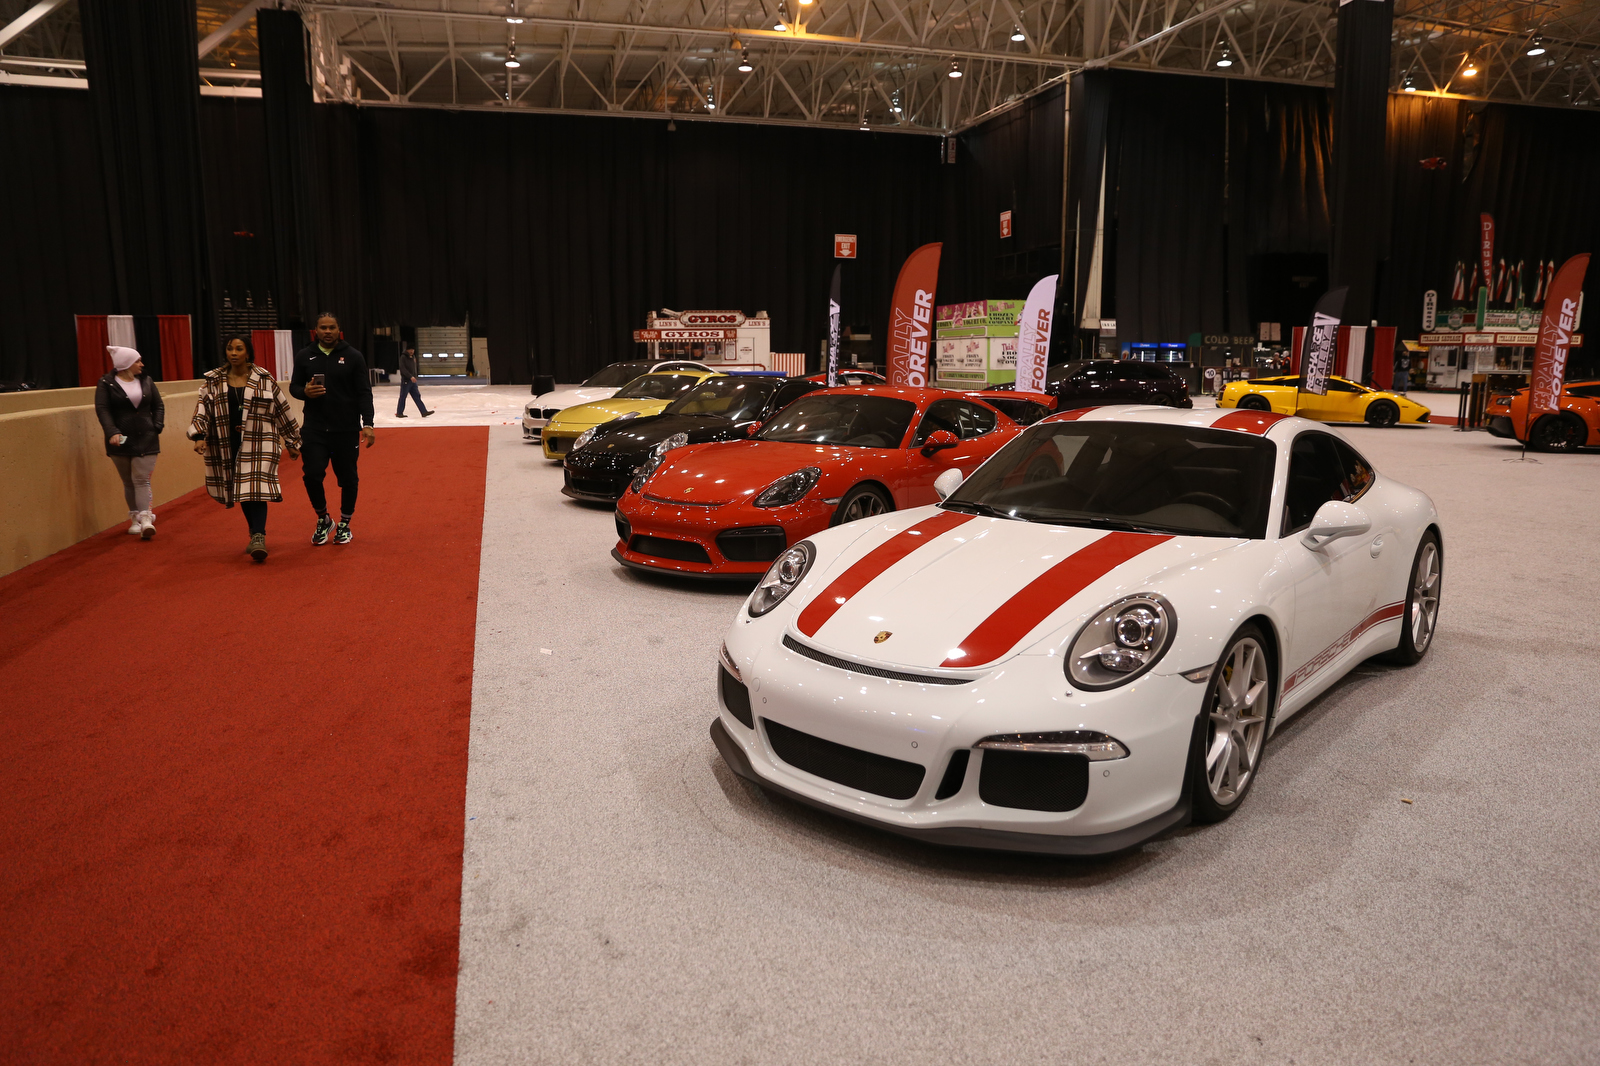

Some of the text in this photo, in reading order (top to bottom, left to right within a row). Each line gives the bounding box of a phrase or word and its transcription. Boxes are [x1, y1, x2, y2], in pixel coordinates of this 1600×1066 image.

[688, 315, 737, 323] GYROS
[892, 307, 912, 386] RALLY
[908, 289, 933, 387] OREVER
[1031, 308, 1050, 392] FOREVER
[1204, 335, 1255, 345] COLD BEER
[1549, 298, 1577, 411] FOREVER
[1315, 334, 1330, 387] RALLY
